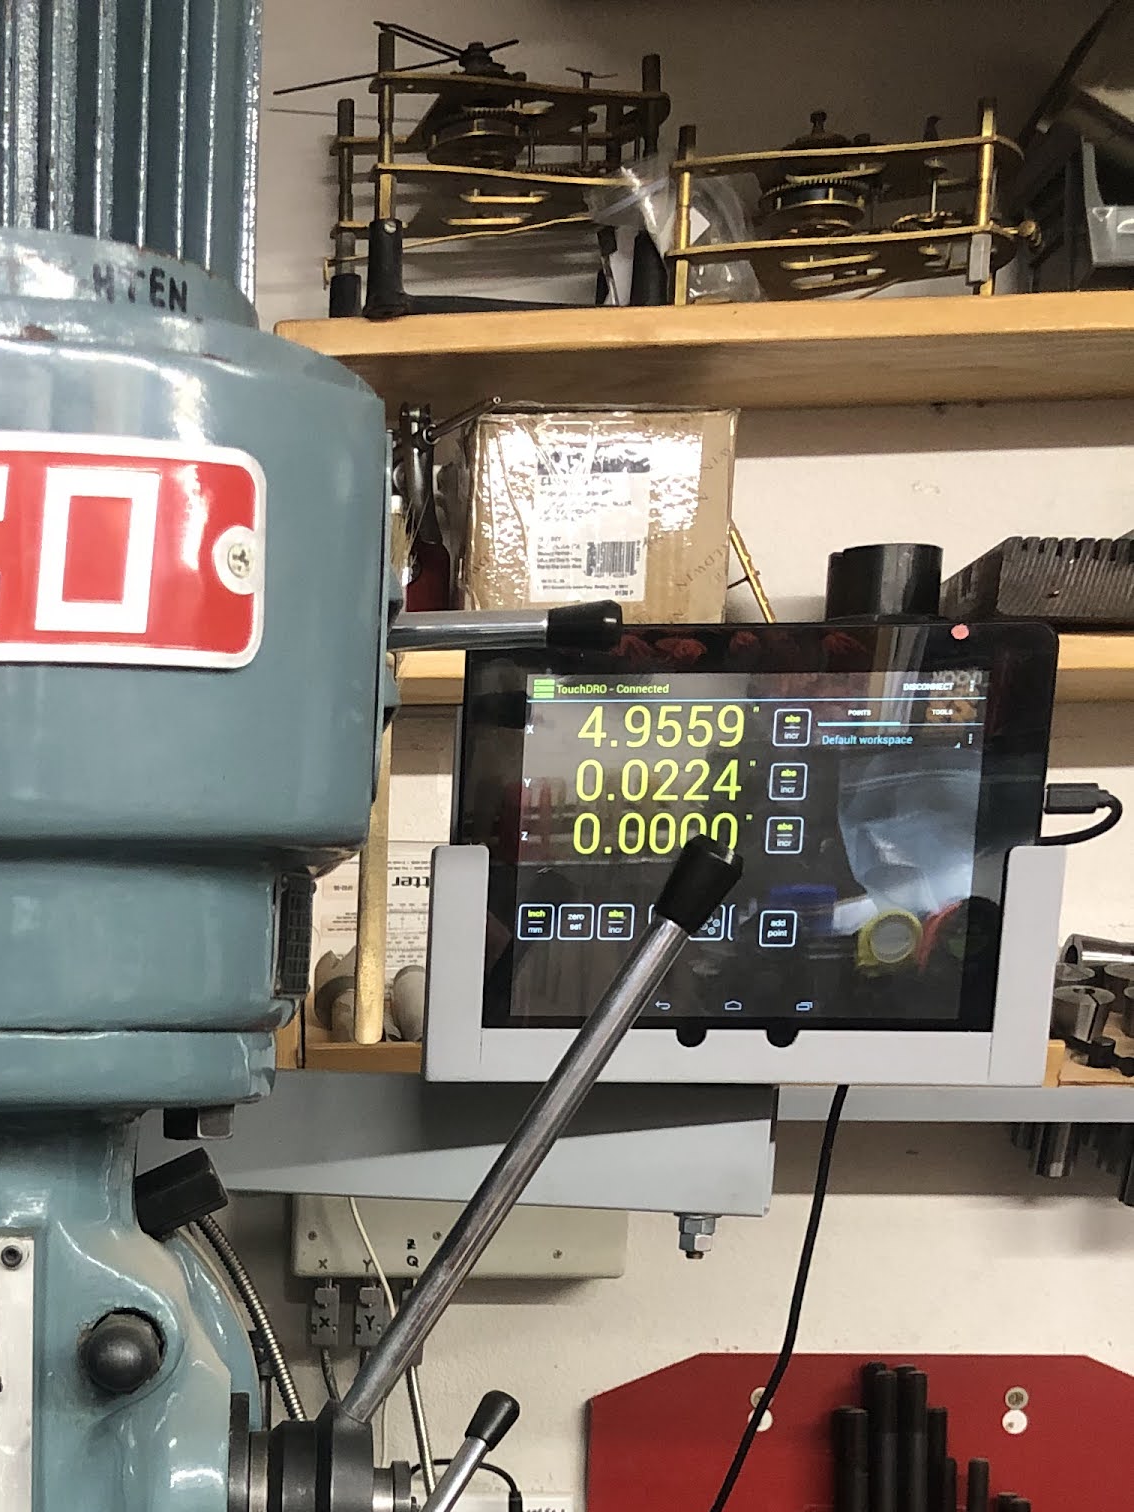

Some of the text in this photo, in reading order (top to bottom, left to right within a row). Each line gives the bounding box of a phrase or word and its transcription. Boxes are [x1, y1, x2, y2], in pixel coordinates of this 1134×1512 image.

[557, 684, 608, 694] TouchDRO
[617, 684, 670, 694] Connected
[903, 682, 954, 691] DISCONNECT
[822, 735, 913, 749] Default workspace
[527, 909, 546, 918] inch
[567, 913, 585, 922] zero
[770, 919, 787, 928] add
[528, 927, 544, 935] mm
[767, 929, 788, 939] point
[318, 1258, 328, 1269] X
[362, 1258, 373, 1272] Y
[406, 1255, 419, 1269] Q
[319, 1316, 330, 1329] X
[364, 1315, 375, 1331] Y
